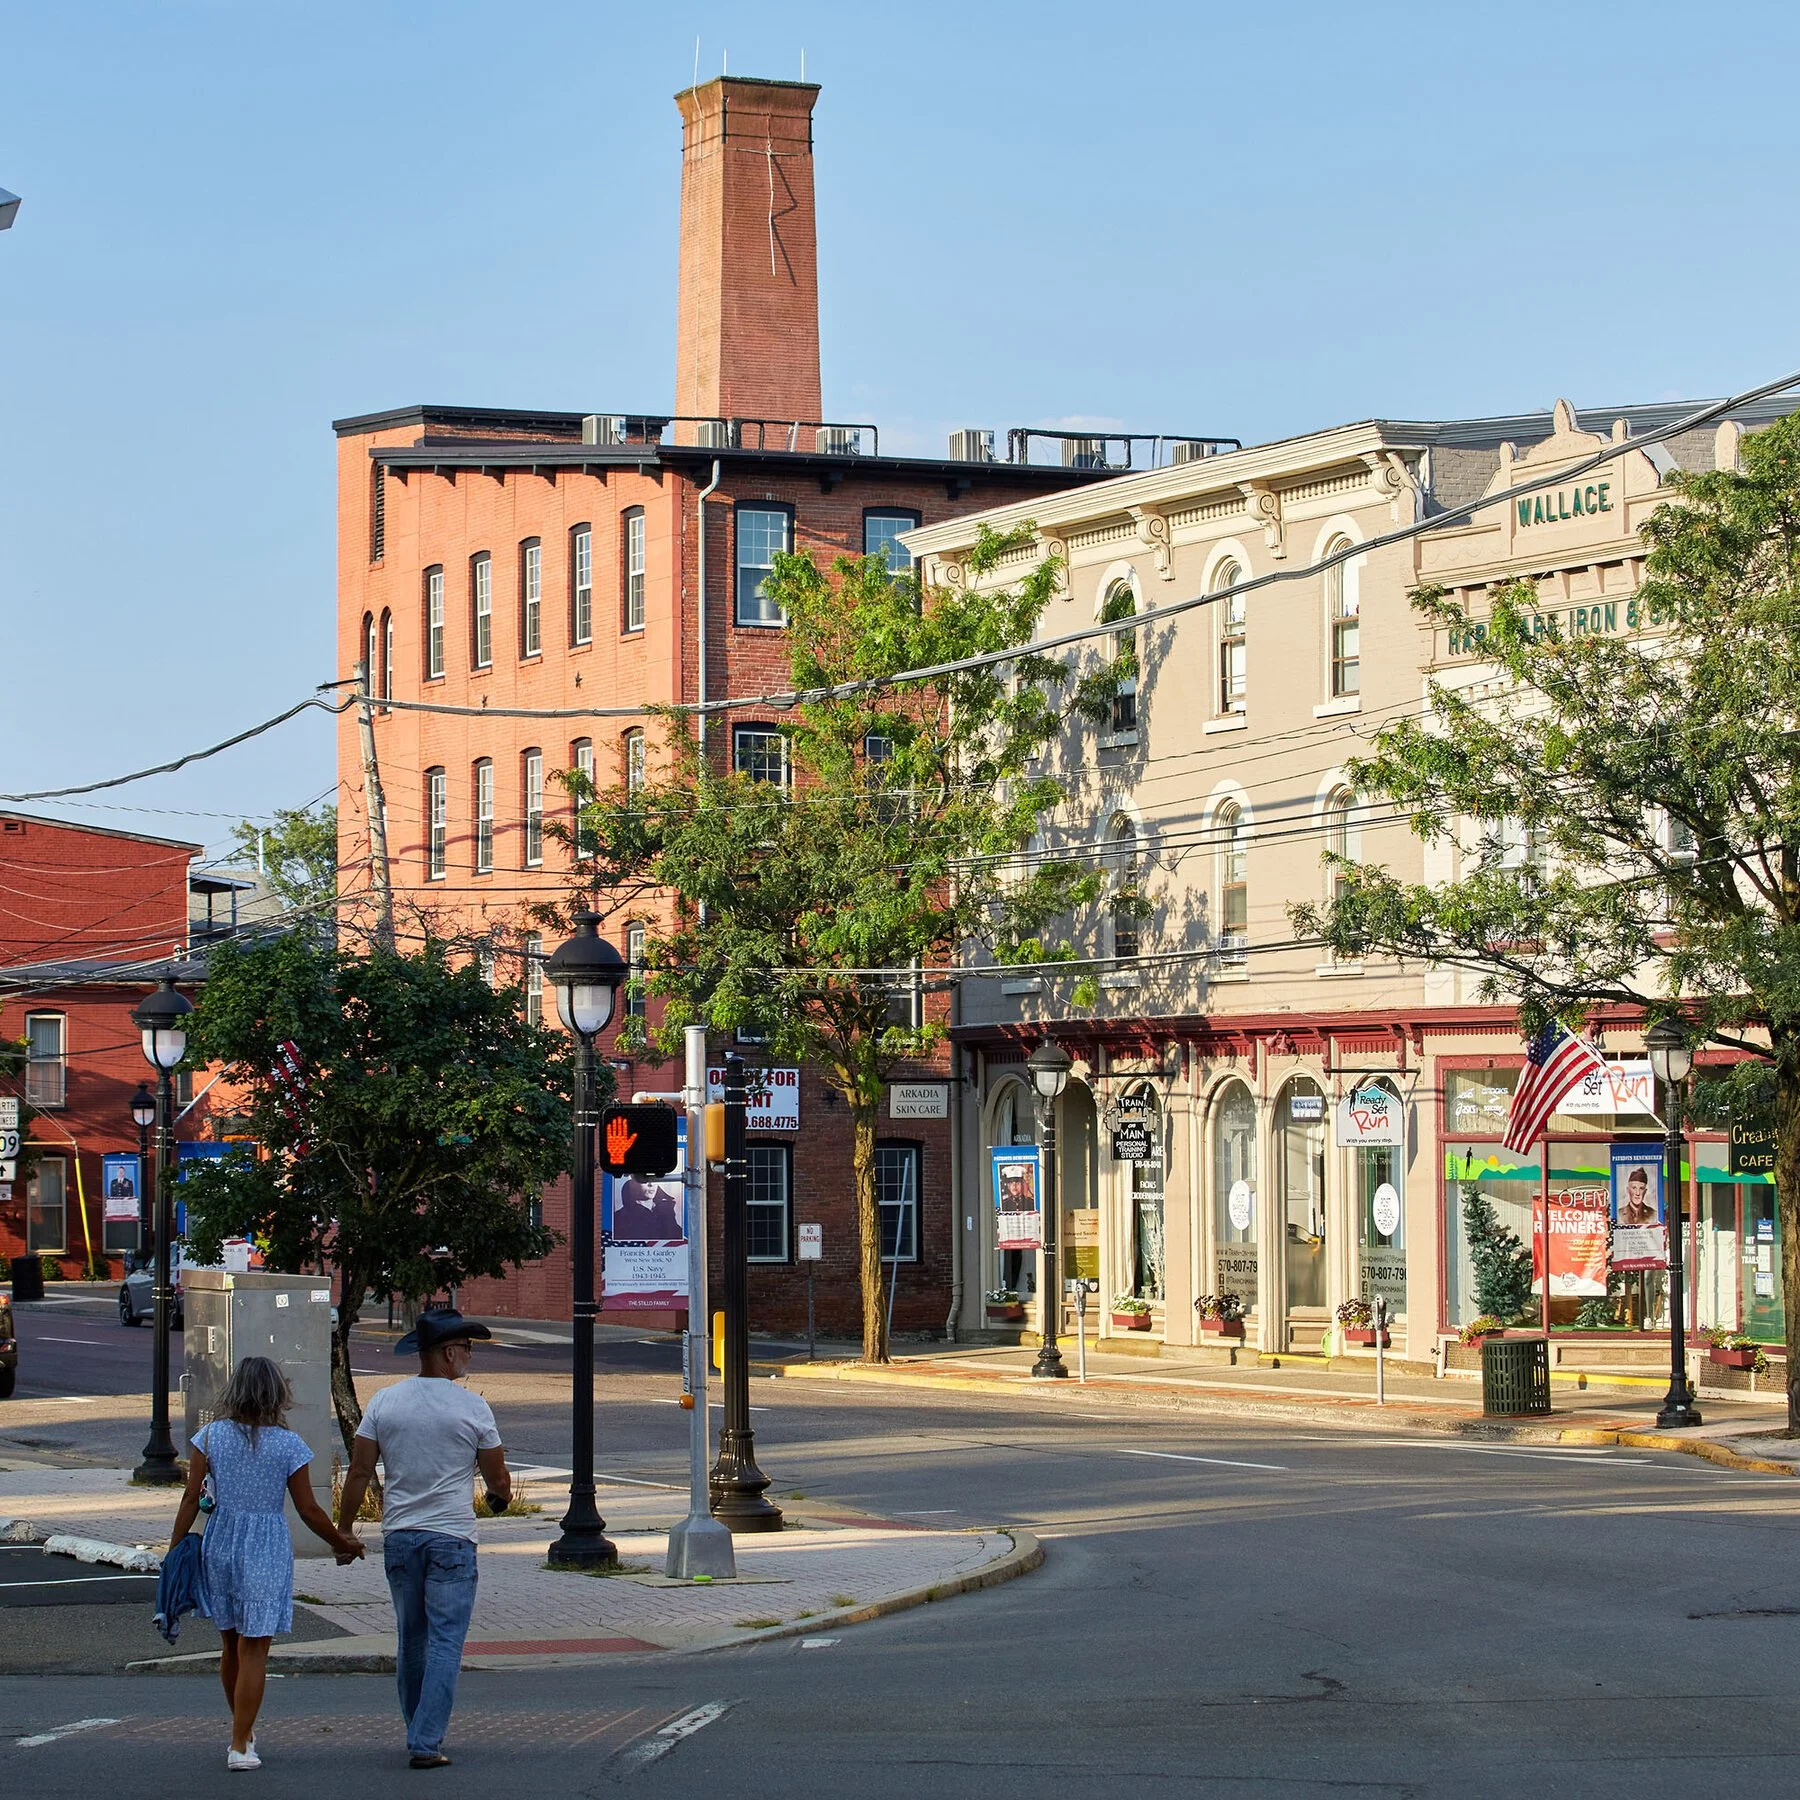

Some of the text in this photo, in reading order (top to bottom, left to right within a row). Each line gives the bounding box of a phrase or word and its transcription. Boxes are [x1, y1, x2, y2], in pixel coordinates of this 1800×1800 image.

[1569, 602, 1616, 639] IRON
[1626, 600, 1640, 628] &
[1584, 1077, 1602, 1095] Set
[1602, 1065, 1648, 1111] Run
[744, 1091, 773, 1108] ENT
[899, 1089, 939, 1098] ARKADIA
[1120, 1097, 1144, 1107] TRAIN
[1360, 1095, 1387, 1107] Ready
[896, 1105, 941, 1114] SKIN CARE
[1371, 1104, 1389, 1115] Set
[1349, 1110, 1389, 1136] Run
[1120, 1129, 1145, 1139] MAIN
[1739, 1155, 1773, 1167] CAFE
[1559, 1190, 1606, 1208] OPEN
